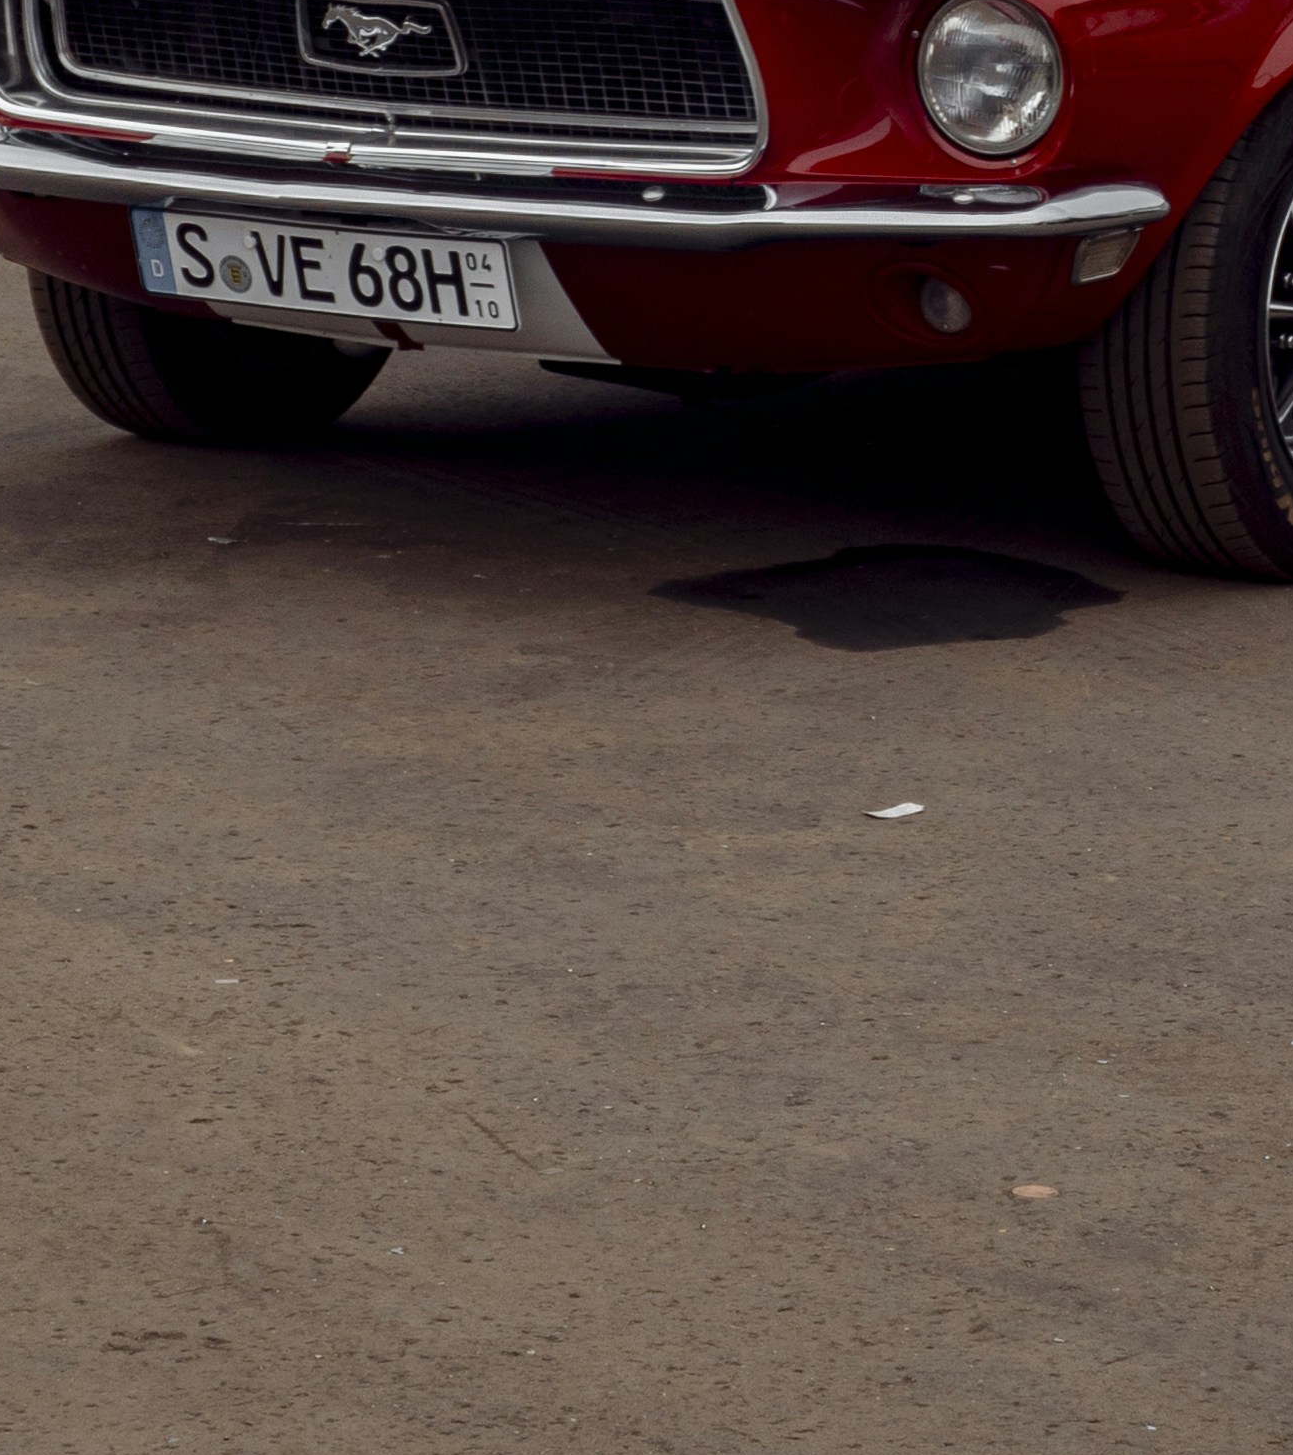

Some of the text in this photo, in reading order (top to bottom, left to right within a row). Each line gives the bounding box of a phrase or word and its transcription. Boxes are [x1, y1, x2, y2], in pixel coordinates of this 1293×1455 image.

[175, 222, 492, 317] S VE 68H 04
[475, 299, 500, 319] 10
